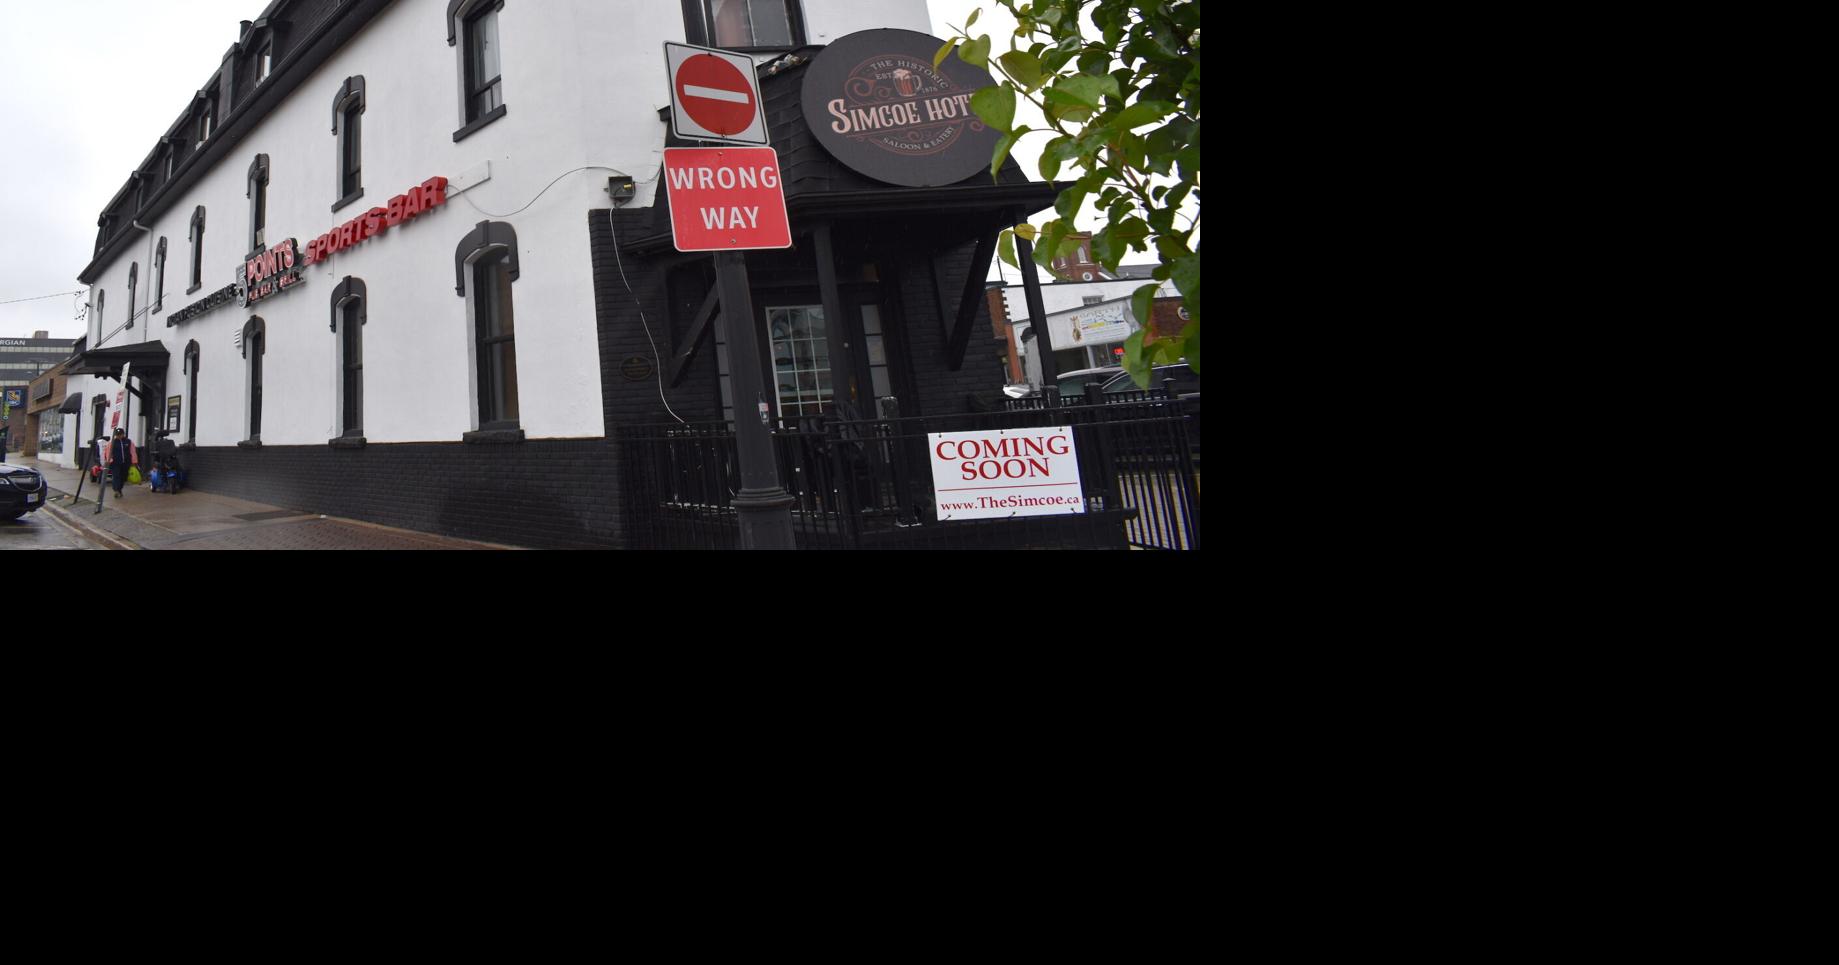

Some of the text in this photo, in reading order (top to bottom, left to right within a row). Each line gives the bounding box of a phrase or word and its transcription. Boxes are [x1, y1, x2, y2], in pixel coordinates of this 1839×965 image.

[870, 60, 949, 89] THE HISTORIC
[827, 92, 975, 134] SIMCOE HOT
[883, 137, 921, 150] SALOON
[931, 126, 955, 147] EATERY
[669, 166, 777, 190] WRONG
[303, 176, 448, 266] SPORTS BAR
[700, 206, 759, 230] WAY
[247, 239, 295, 286] POINTS
[936, 435, 1069, 460] COMING
[961, 457, 1050, 481] SOON
[940, 495, 1080, 511] www.TheSimcoe.ca
